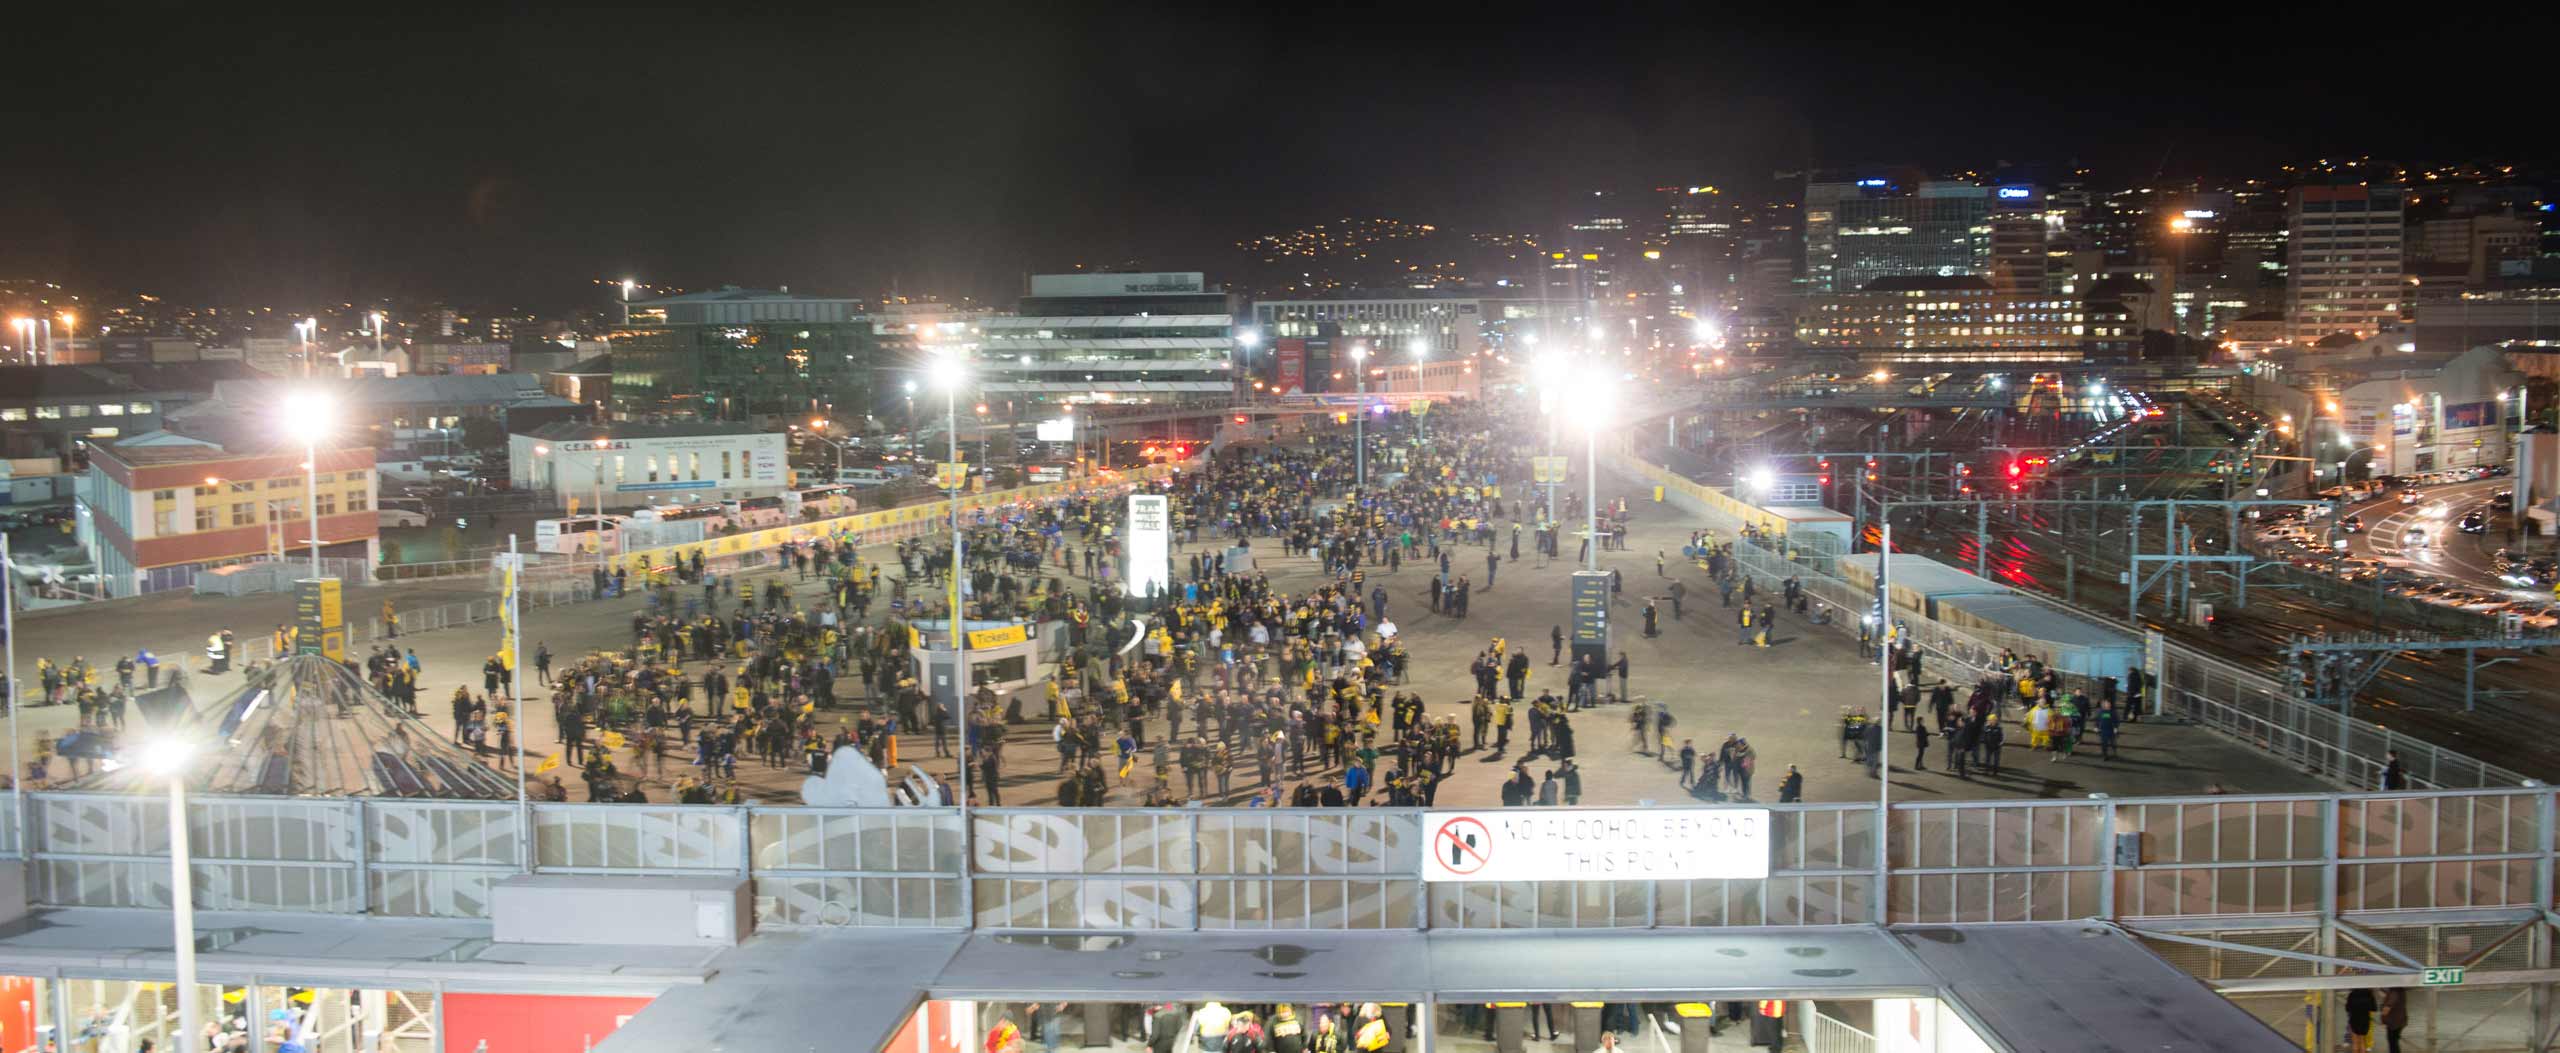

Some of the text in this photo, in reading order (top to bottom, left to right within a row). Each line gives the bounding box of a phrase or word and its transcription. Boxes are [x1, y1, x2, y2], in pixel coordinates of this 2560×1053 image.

[564, 441, 632, 452] CENRAL
[976, 632, 1009, 644] Tickets
[1503, 816, 1758, 840] NO ALCOHOL BEYOND
[1564, 850, 1698, 872] THIS PONT
[2425, 968, 2463, 983] EXIT
